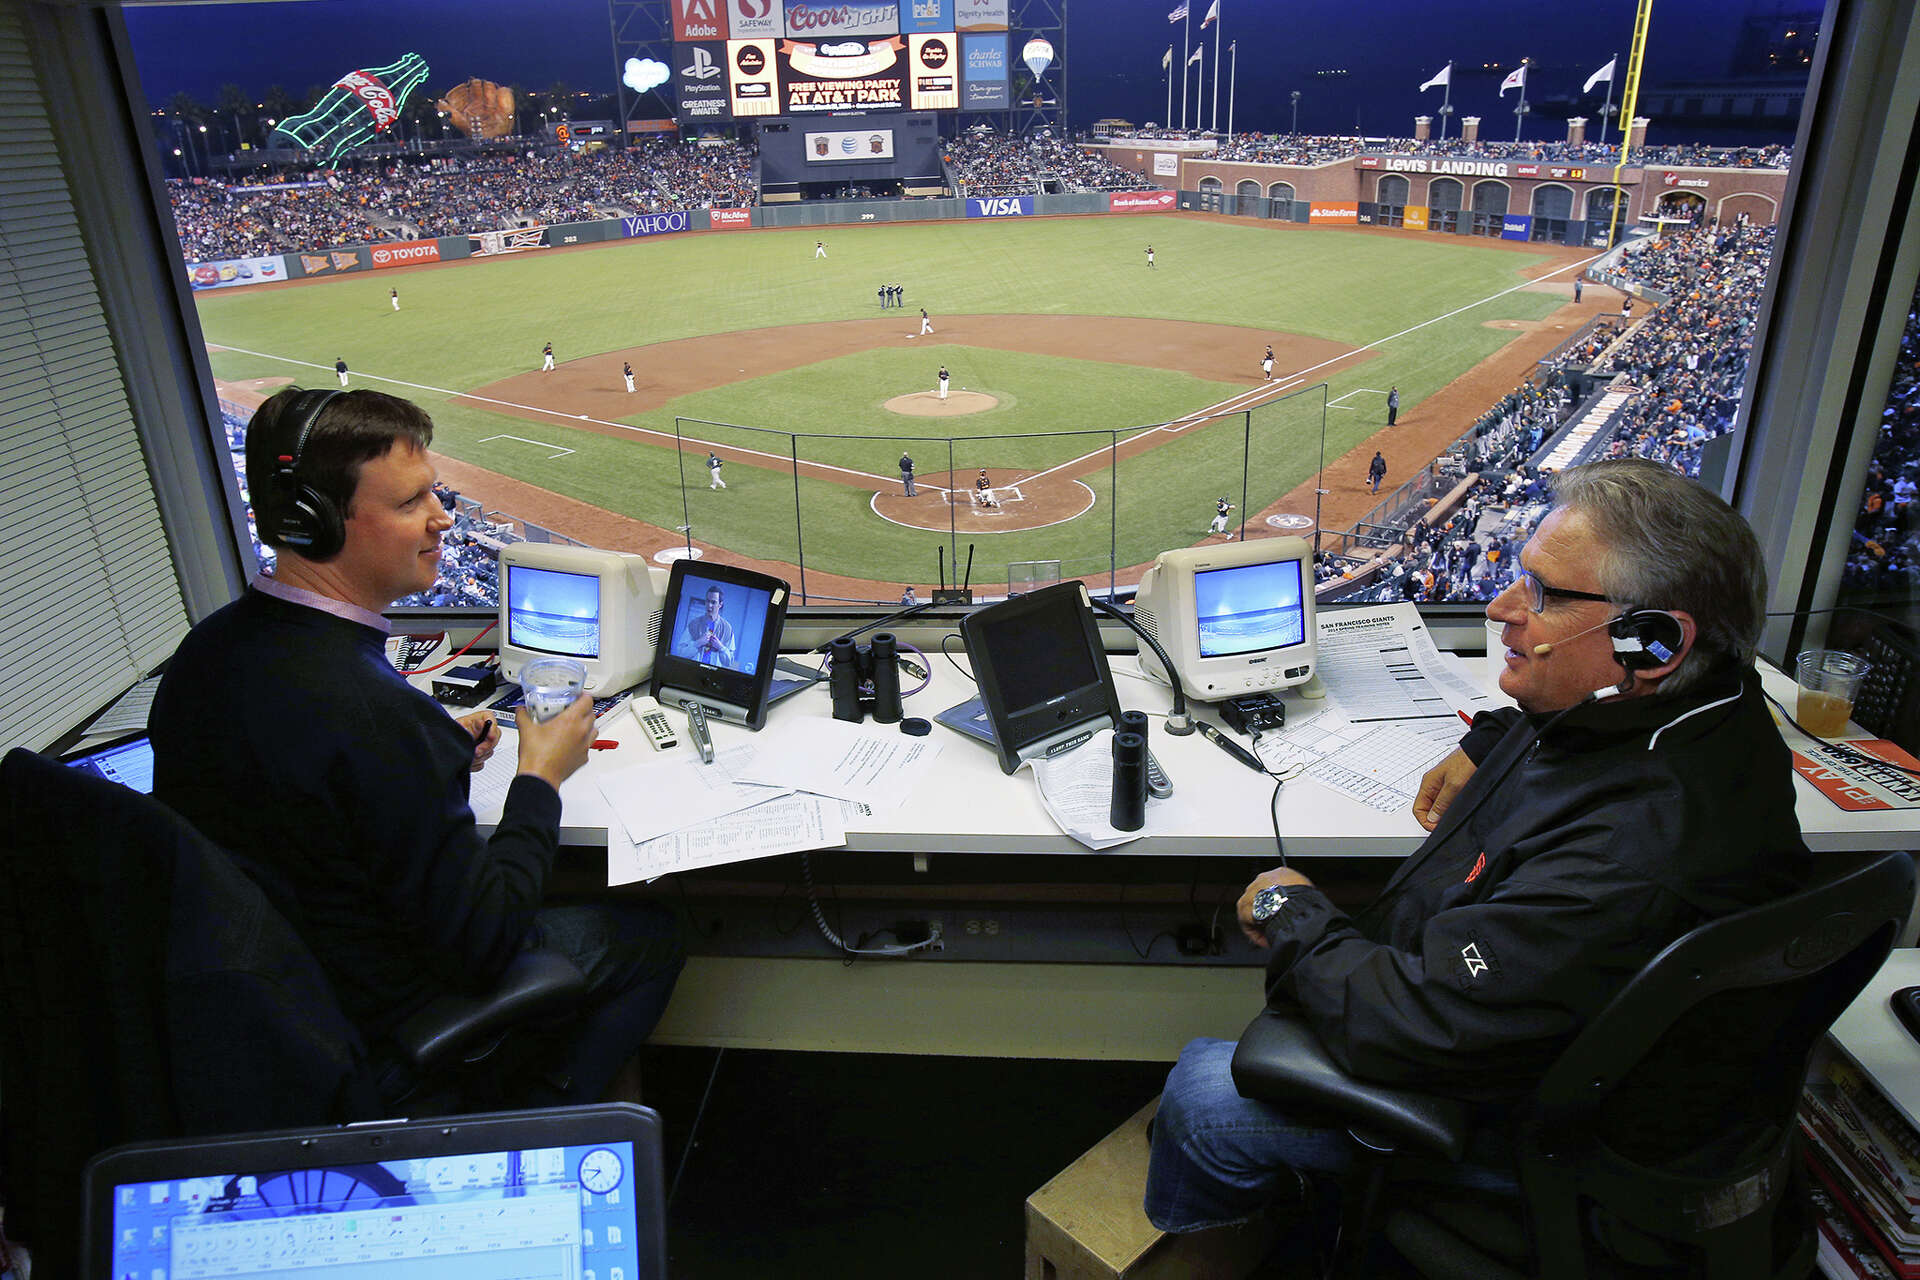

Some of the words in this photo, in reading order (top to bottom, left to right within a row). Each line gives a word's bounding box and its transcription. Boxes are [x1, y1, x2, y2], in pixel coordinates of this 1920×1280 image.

[787, 4, 848, 31] Coors
[959, 9, 981, 19] Dignity
[982, 9, 1005, 17] Health
[685, 23, 718, 37] Adobe
[739, 19, 772, 28] SAFEWAY
[968, 48, 1002, 60] charles
[968, 60, 1002, 68] SCHWAB
[685, 84, 721, 93] PlayStation
[788, 82, 816, 92] FREE
[816, 80, 864, 91] VIEWING
[864, 79, 901, 89] PARTY
[788, 91, 810, 105] AT
[812, 90, 856, 104] AT&T
[857, 88, 901, 102] PARK
[681, 99, 726, 109] GREATNESS
[1431, 160, 1508, 177] LANDING
[976, 198, 1022, 216] VISA
[1135, 198, 1159, 206] America
[721, 211, 749, 220] McAfee
[625, 212, 687, 237] YAHOO!
[392, 245, 438, 260] TOYOTA
[1335, 618, 1371, 628] FRANCISCO
[1371, 615, 1395, 624] GIANTS
[1855, 764, 1920, 801] KNBR
